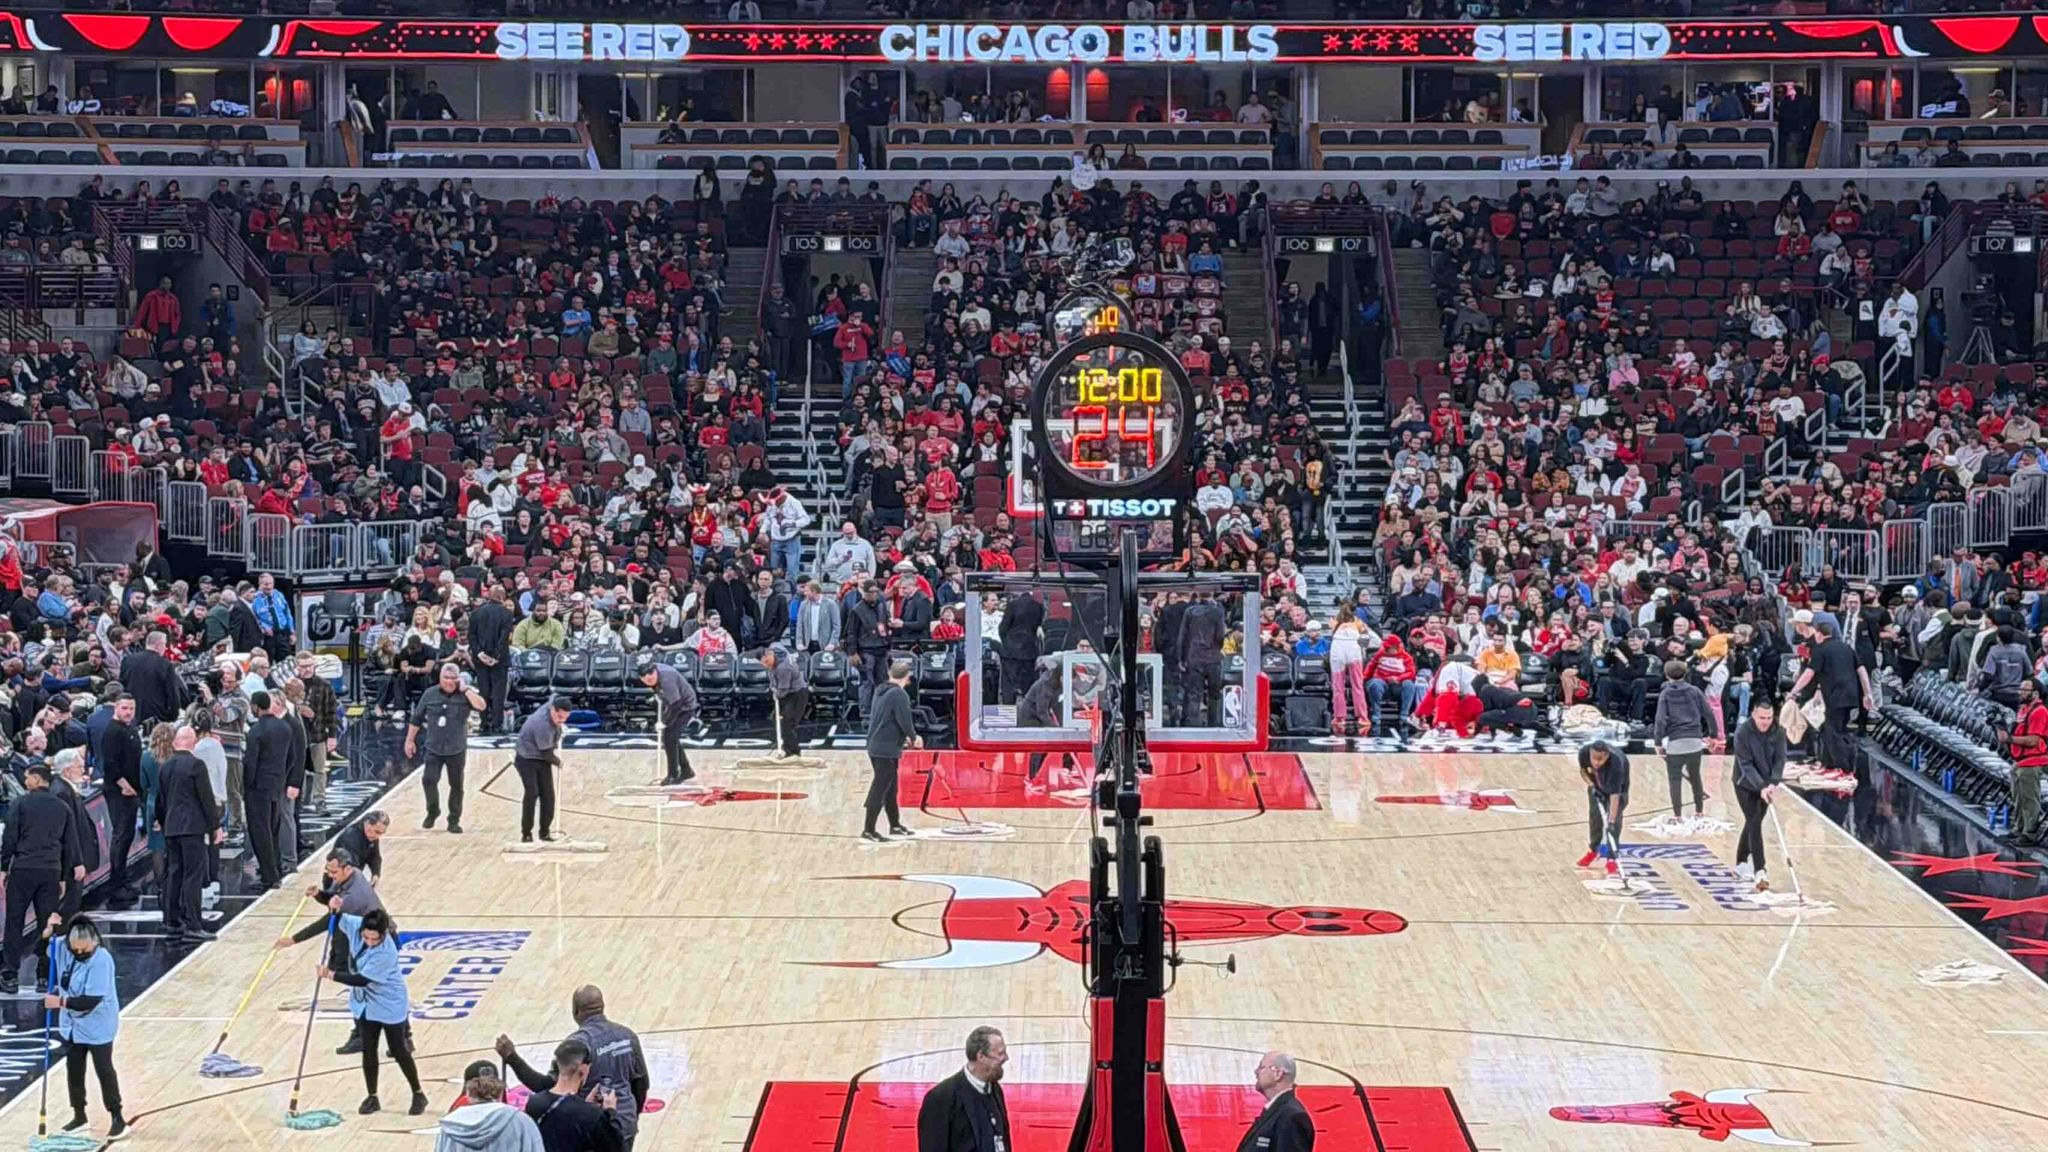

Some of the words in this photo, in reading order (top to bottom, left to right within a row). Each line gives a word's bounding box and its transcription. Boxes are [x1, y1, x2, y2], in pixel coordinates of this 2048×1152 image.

[494, 23, 584, 60] SEE
[592, 23, 691, 60] RED
[879, 24, 1110, 62] CHICAGO
[1123, 24, 1279, 62] BULLS
[1473, 24, 1563, 61] SEE
[1571, 23, 1671, 60] RED
[163, 236, 186, 248] 105
[795, 238, 818, 249] 105
[848, 238, 872, 250] 106
[1285, 239, 1309, 250] 106
[1342, 239, 1361, 250] 107
[1986, 238, 2006, 250] 107
[1080, 368, 1162, 402] 12:00
[1072, 405, 1155, 469] 24
[1087, 499, 1176, 516] TISSOT
[412, 956, 513, 1020] CENTER
